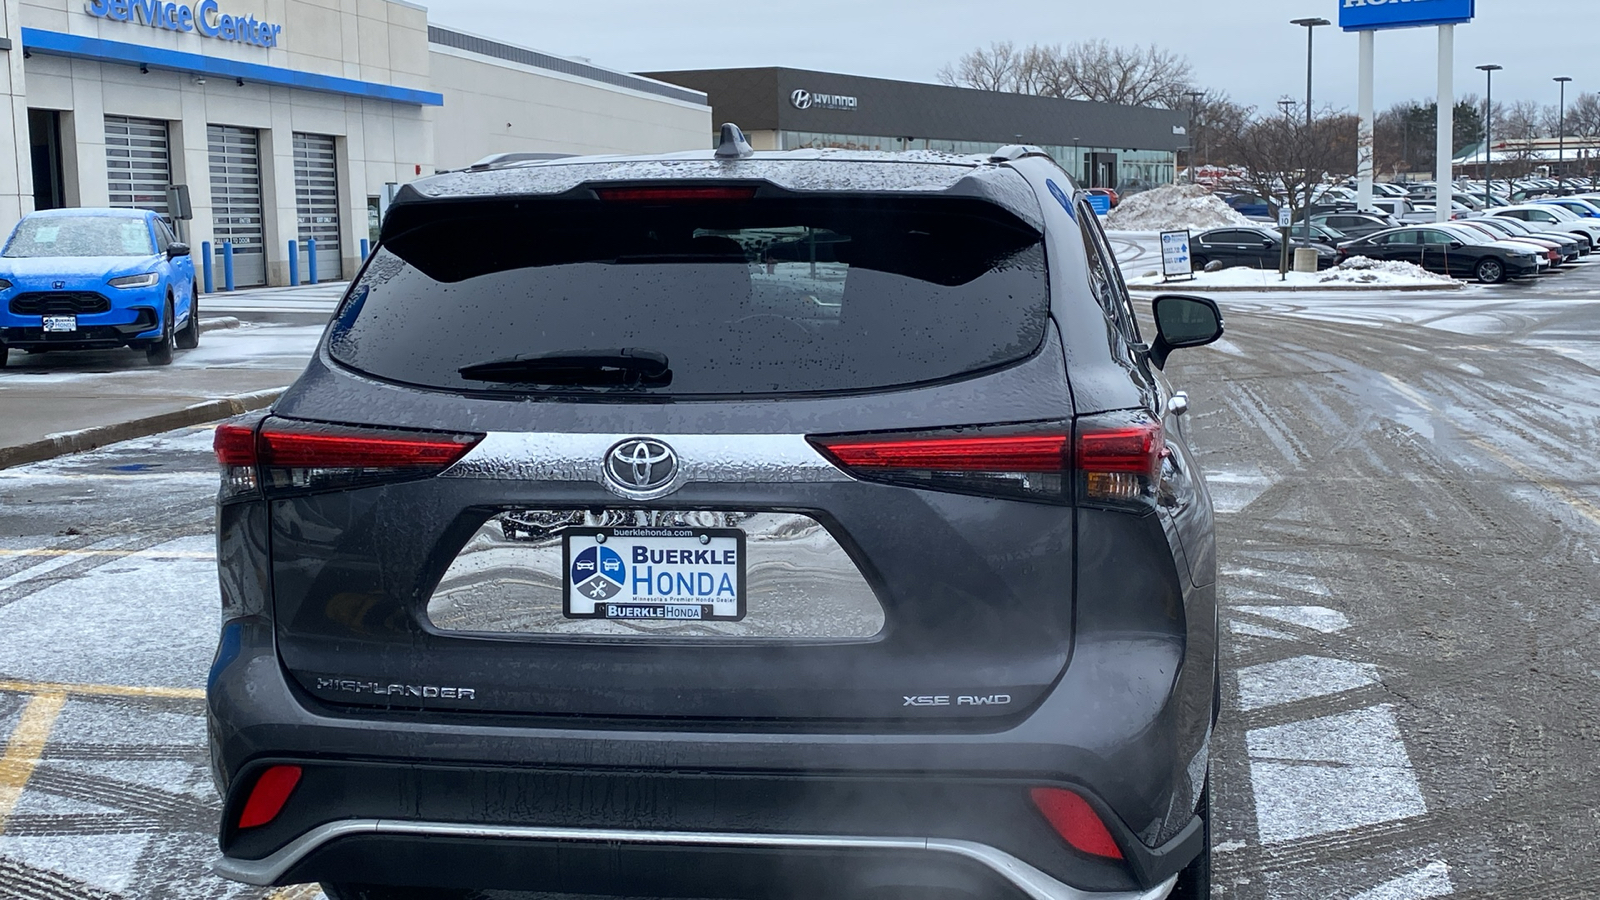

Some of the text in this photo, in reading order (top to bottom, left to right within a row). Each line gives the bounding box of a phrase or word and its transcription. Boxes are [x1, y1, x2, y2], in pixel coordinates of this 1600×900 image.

[196, 0, 281, 47] Center
[613, 528, 693, 537] buerklehonda.com
[632, 545, 736, 565] BUERKLE
[632, 565, 736, 597] HONDA
[317, 677, 475, 700] HIGHLANDER
[903, 694, 1011, 706] XSE AWD
